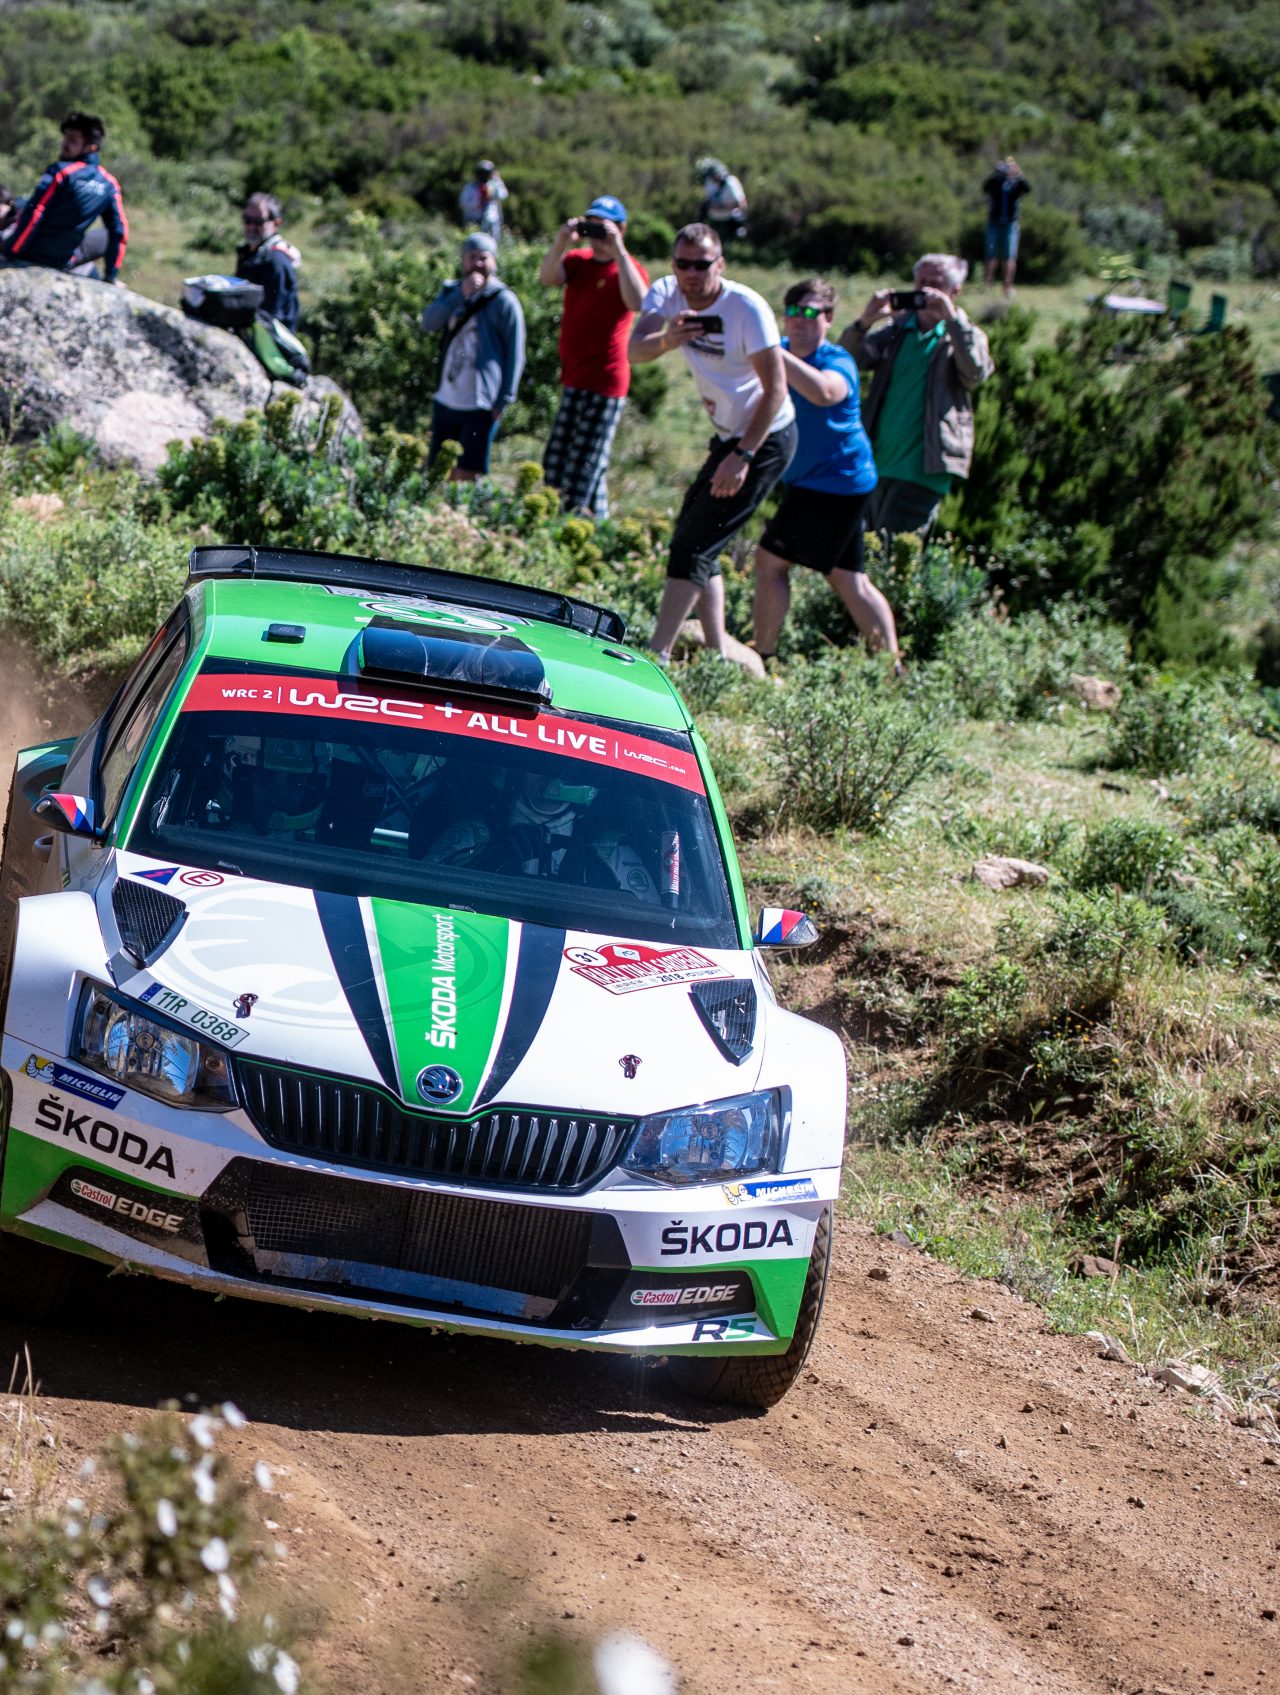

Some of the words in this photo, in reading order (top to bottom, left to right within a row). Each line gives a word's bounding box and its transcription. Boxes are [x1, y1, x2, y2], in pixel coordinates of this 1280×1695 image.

[221, 688, 258, 699] WRC
[263, 689, 273, 699] 2
[289, 688, 424, 720] WRC
[467, 713, 528, 738] ALL
[538, 725, 607, 756] LIVE
[187, 872, 219, 885] E
[432, 913, 460, 973] Motorsport
[575, 952, 599, 963] 31
[579, 964, 634, 984] RALLY
[615, 960, 666, 978] ITALIA
[644, 949, 715, 973] SARDEGNA
[657, 973, 685, 982] 2018
[157, 991, 188, 1014] 11R
[190, 1006, 239, 1042] 0368
[425, 976, 457, 1050] ŠKODA
[59, 1072, 122, 1103] MICHELIN
[34, 1093, 176, 1179] ŠKODA
[81, 1184, 113, 1207] Castrol
[114, 1197, 184, 1233] EDGE
[755, 1184, 814, 1198] MICHELIN
[660, 1219, 794, 1256] ŠKODA
[643, 1291, 678, 1304] Castrol
[677, 1284, 741, 1305] EDGE
[691, 1317, 757, 1342] R5
